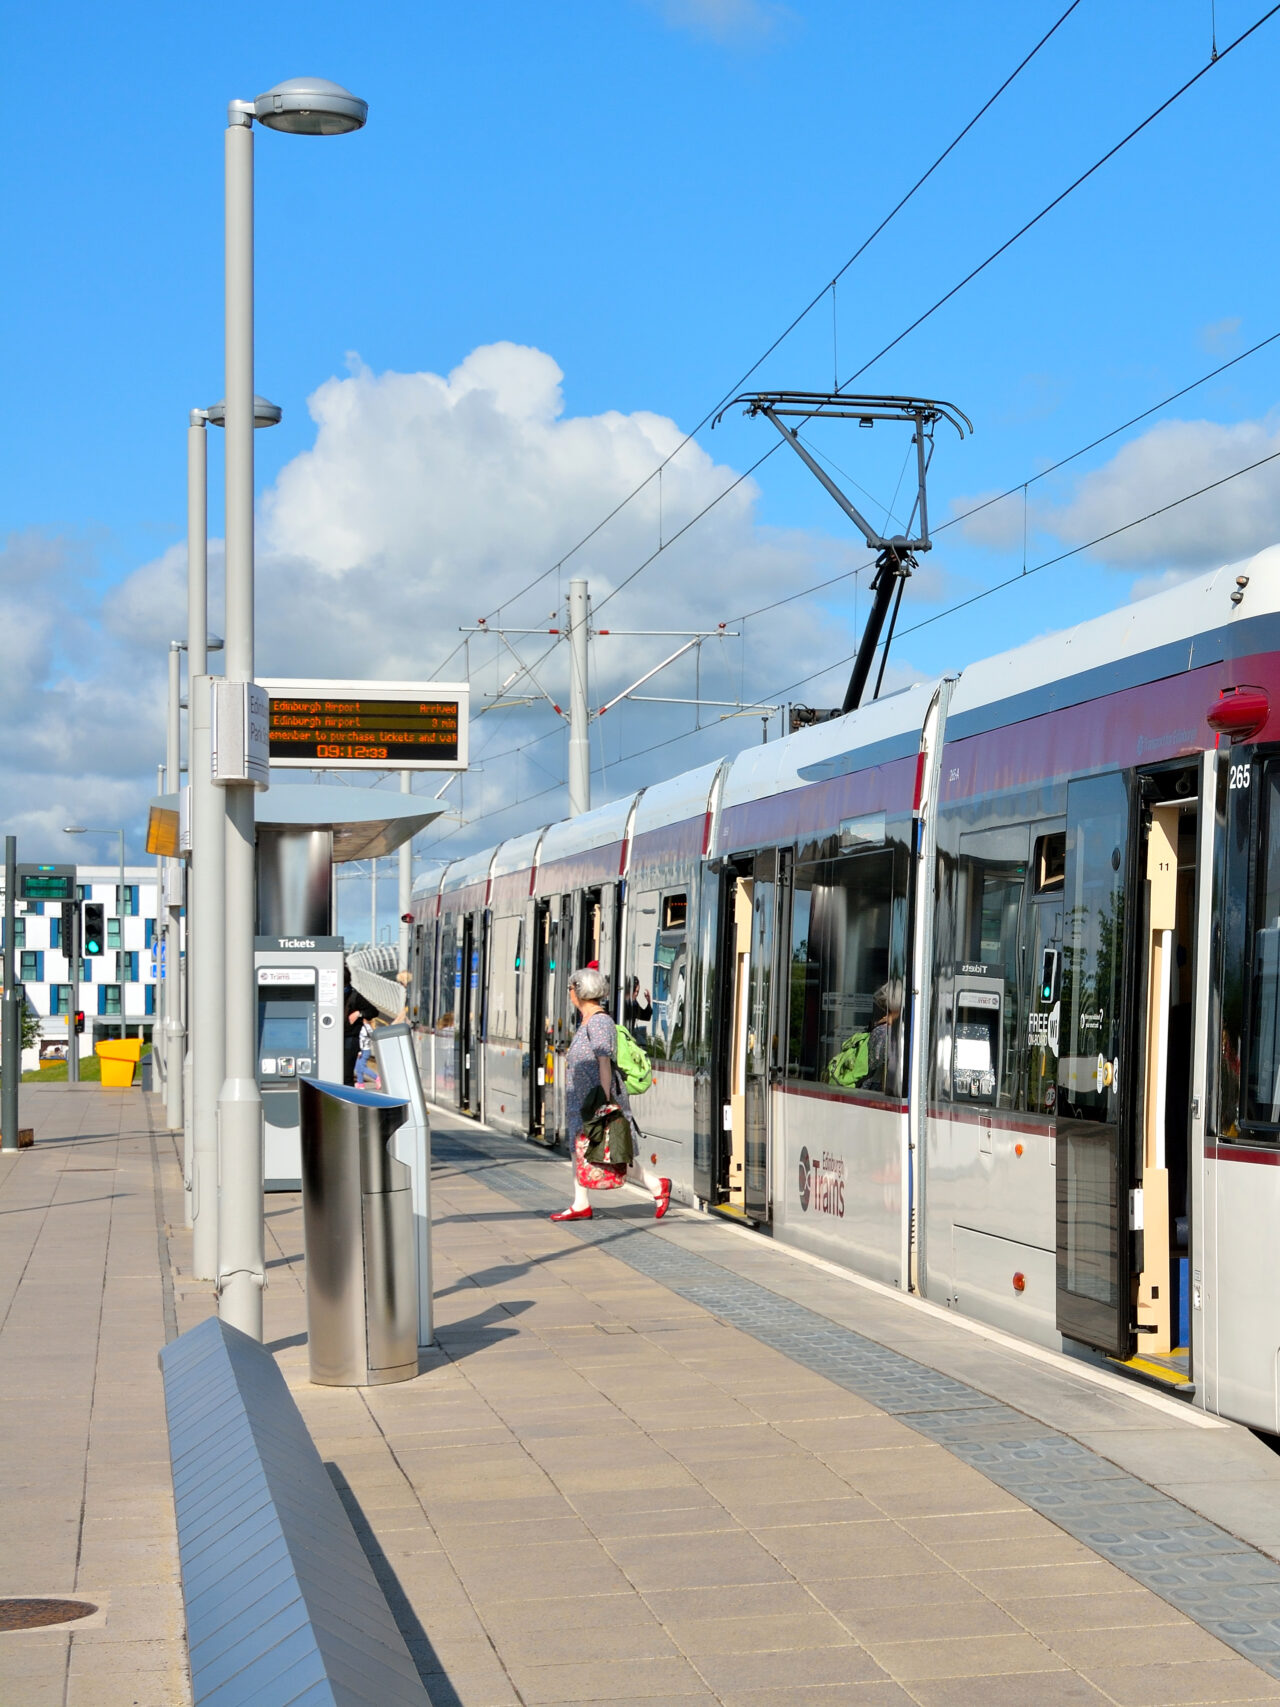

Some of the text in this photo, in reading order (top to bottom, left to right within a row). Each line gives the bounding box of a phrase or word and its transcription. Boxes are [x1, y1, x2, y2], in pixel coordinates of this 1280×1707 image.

[273, 701, 457, 714] Edinburgh Airport Arrived
[273, 715, 321, 728] Edinburgh
[324, 716, 361, 728] Airport
[315, 730, 327, 740] to
[330, 731, 375, 743] purchase
[379, 732, 414, 742] tickets
[418, 732, 436, 742] and
[1229, 764, 1251, 789] 265
[278, 938, 316, 948] Tickets
[1028, 1013, 1048, 1032] FREE
[812, 1159, 845, 1219] Trams
